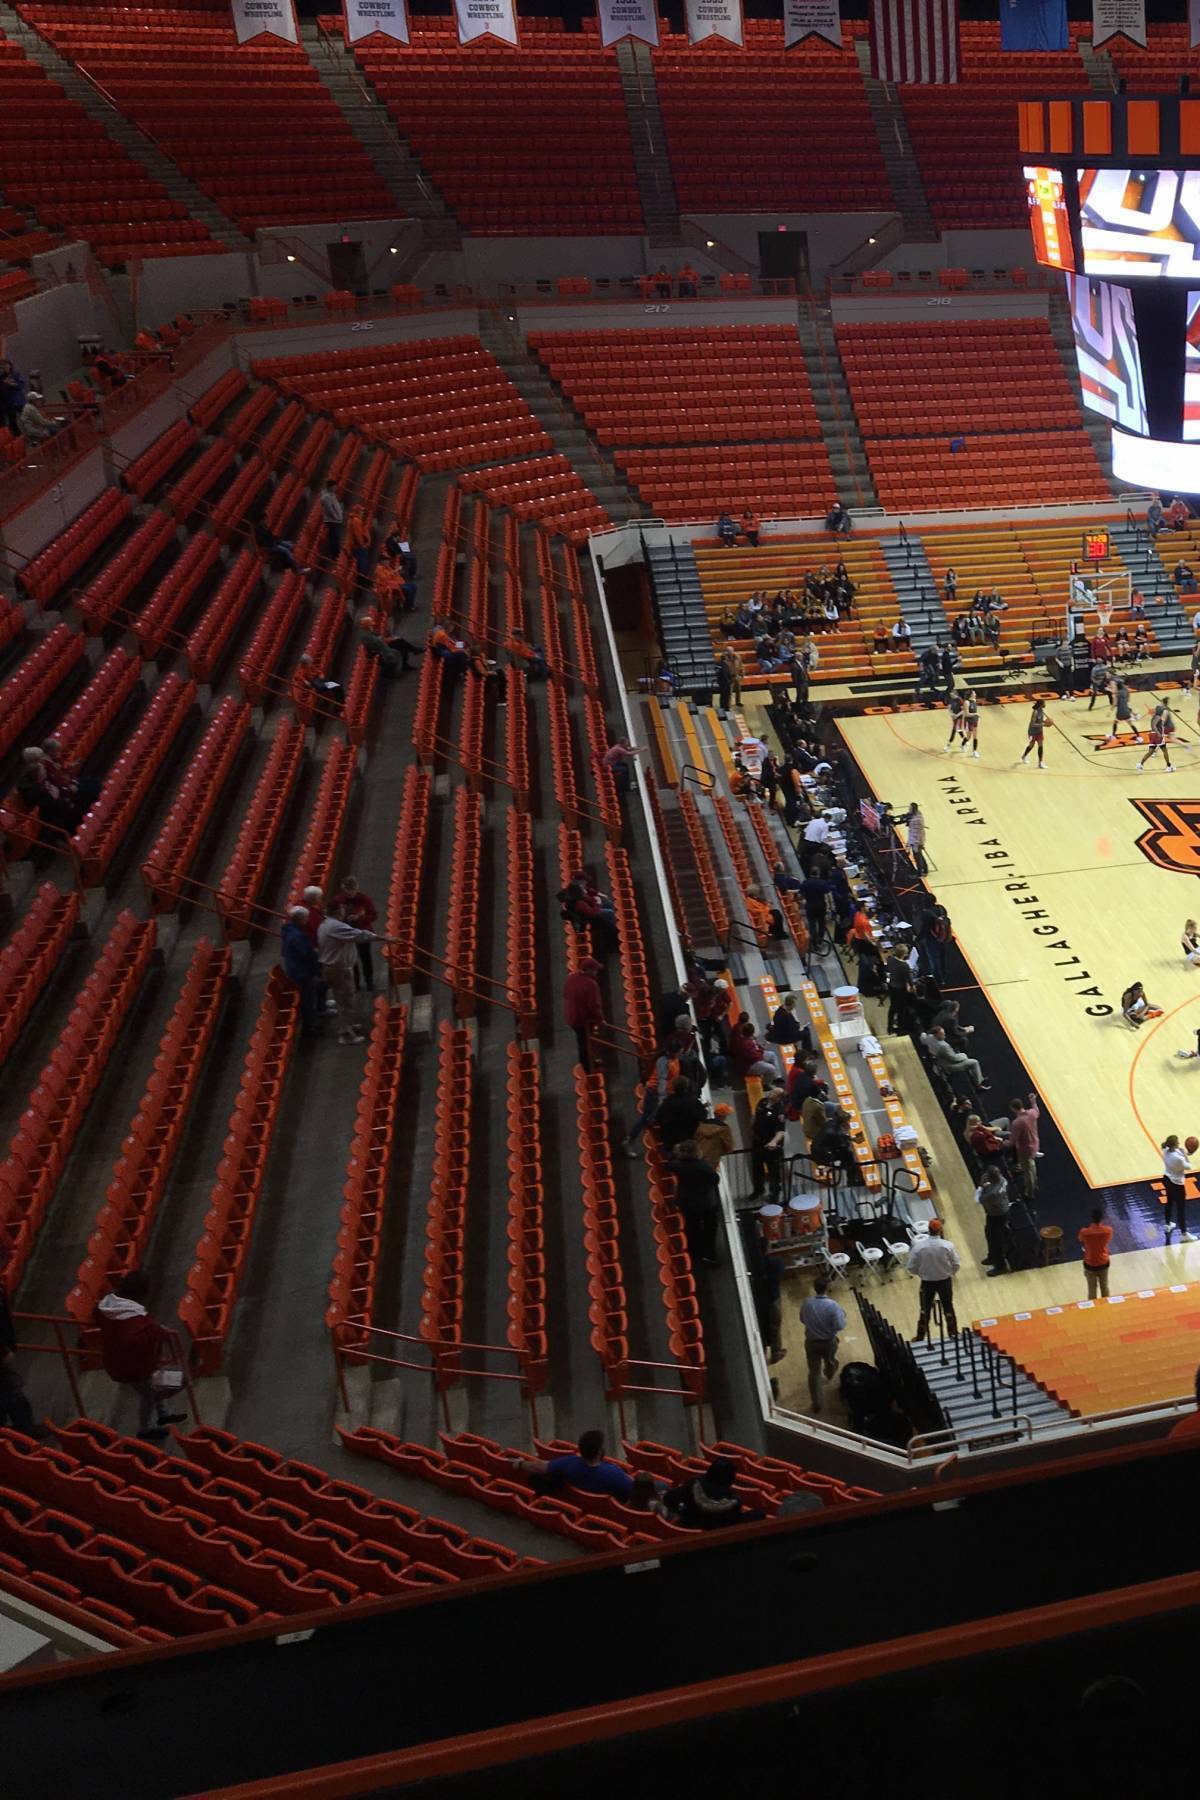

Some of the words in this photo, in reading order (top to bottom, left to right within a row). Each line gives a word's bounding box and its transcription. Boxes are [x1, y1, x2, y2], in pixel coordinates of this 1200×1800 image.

[245, 2, 279, 10] COWBOY
[358, 1, 391, 10] COWBOY
[468, 4, 500, 12] COWBOY
[356, 10, 396, 18] WRESTLING
[611, 6, 642, 14] COWBOY
[697, 6, 728, 14] COWBOY
[927, 297, 952, 306] 218
[644, 304, 670, 314] 217
[1089, 542, 1105, 557] 30
[938, 775, 987, 825] ARENA
